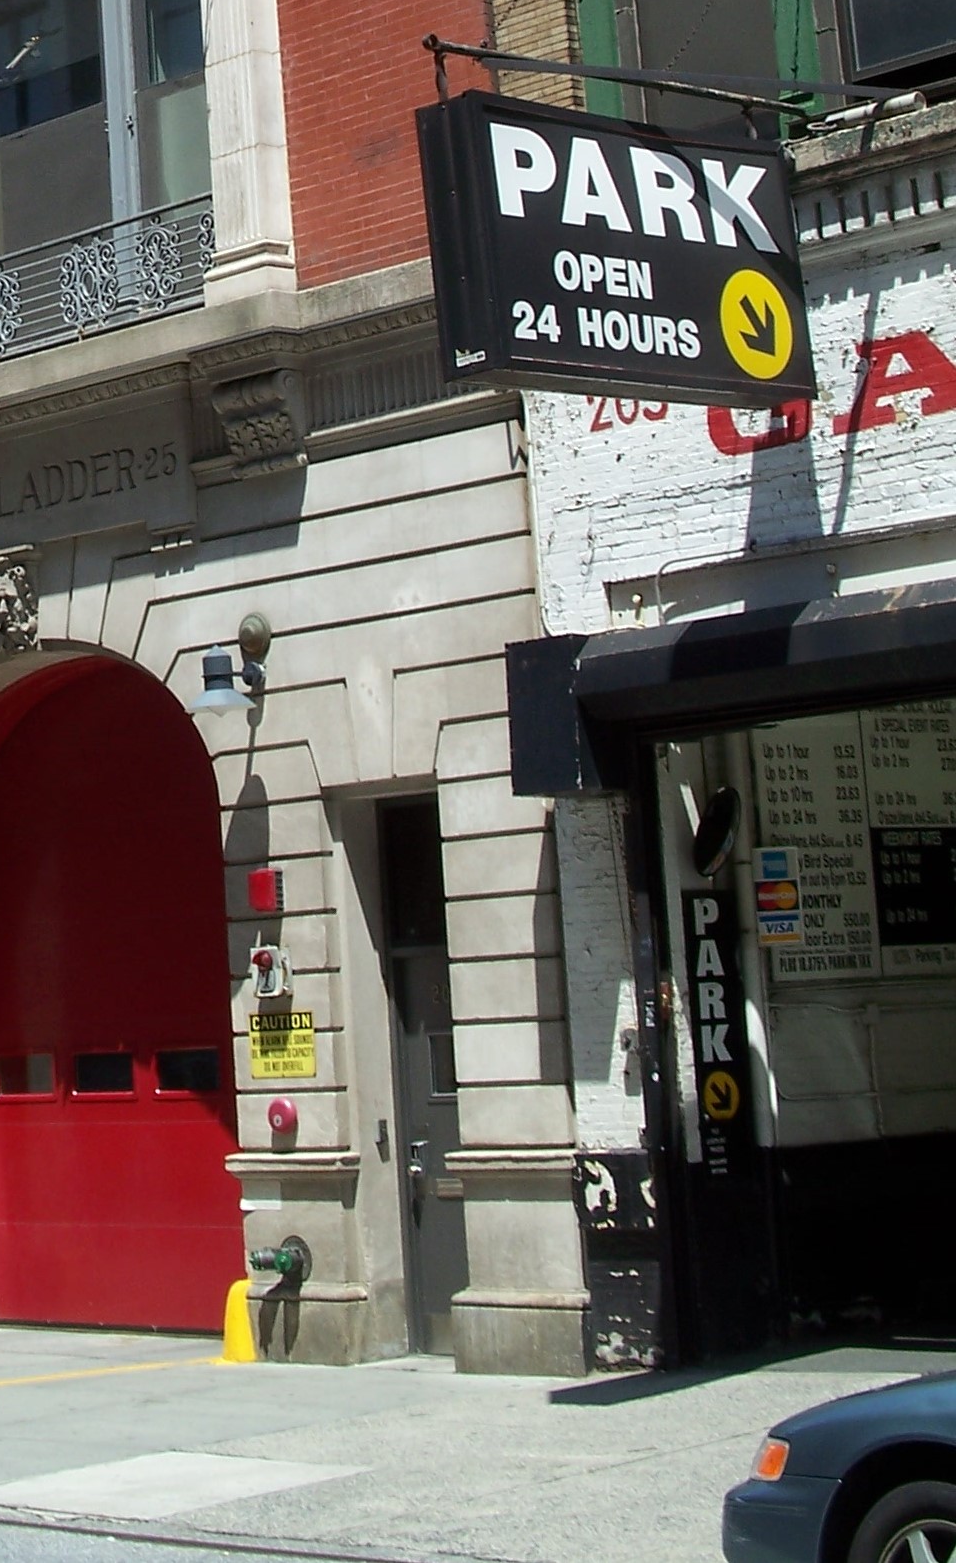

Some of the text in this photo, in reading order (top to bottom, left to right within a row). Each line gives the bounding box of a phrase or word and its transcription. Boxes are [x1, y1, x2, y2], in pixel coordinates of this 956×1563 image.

[489, 122, 780, 253] PARK
[554, 251, 653, 300] OPEN
[512, 301, 701, 358] 24 HOURS
[763, 743, 774, 760] Up
[776, 744, 785, 758] to
[793, 744, 809, 759] hour
[764, 765, 775, 783] Up
[778, 766, 786, 781] to
[796, 766, 809, 781] hrs
[767, 787, 778, 805] Up
[780, 787, 788, 802] to
[791, 786, 801, 802] 10
[801, 788, 813, 803] hrs
[768, 809, 780, 827] Up
[782, 809, 790, 824] to
[793, 808, 803, 824] 24
[805, 810, 817, 824] hrs
[823, 853, 853, 871] Special
[765, 922, 794, 934] VISA
[694, 898, 733, 1063] PARK
[252, 1014, 310, 1030] CAUTION
